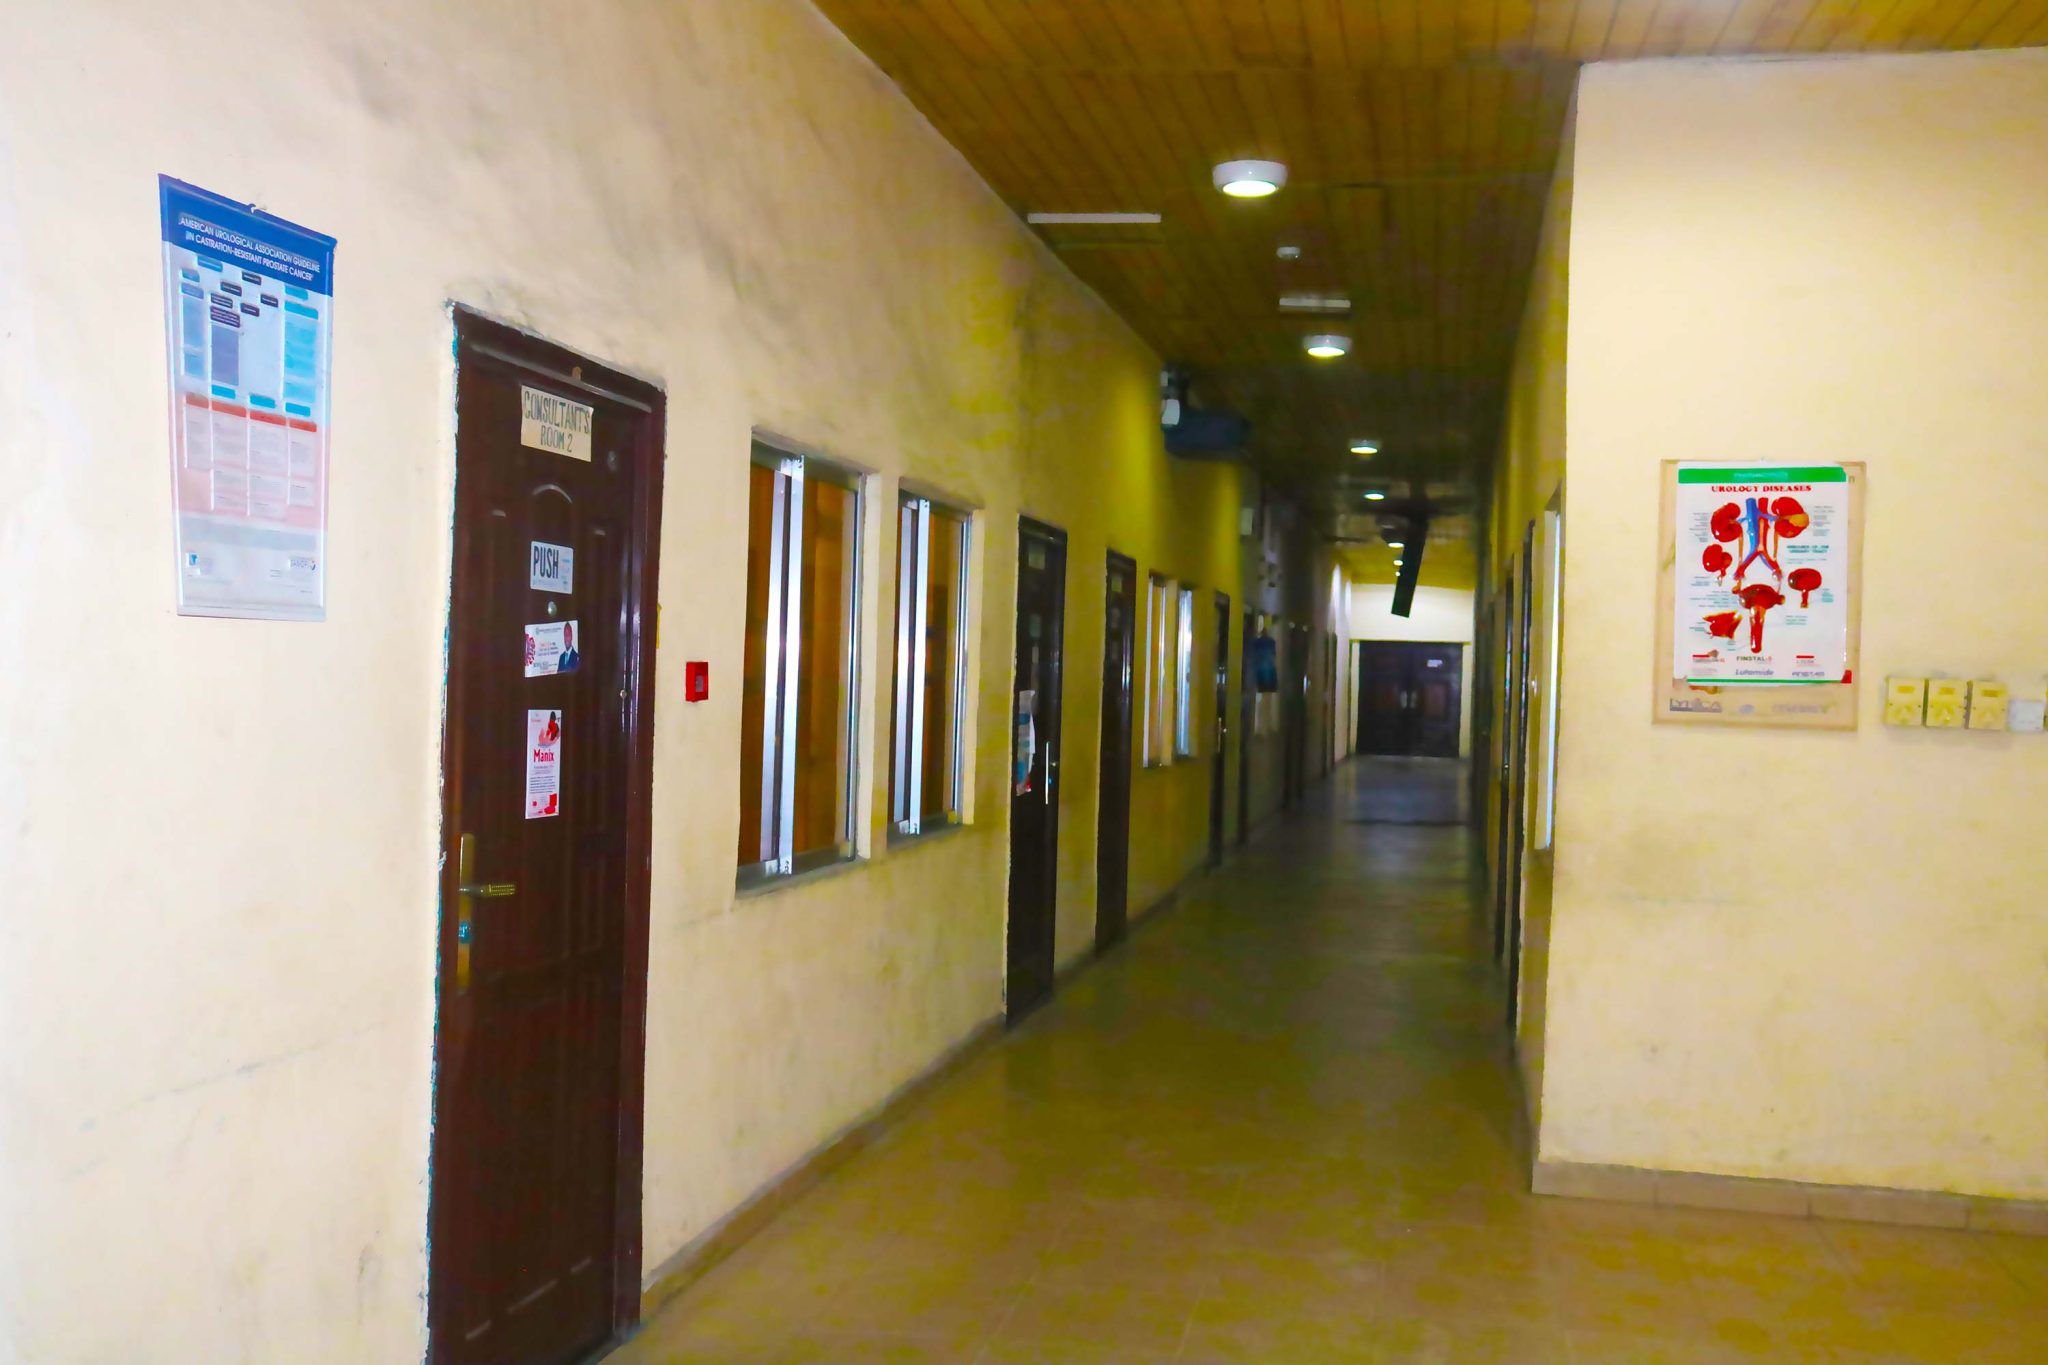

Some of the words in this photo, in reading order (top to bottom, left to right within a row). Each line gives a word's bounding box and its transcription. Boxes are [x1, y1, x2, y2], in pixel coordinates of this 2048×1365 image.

[178, 216, 215, 236] AMERICAN
[215, 228, 254, 250] UROLOGICAL
[254, 243, 293, 264] ASSOCIATION
[292, 256, 321, 273] GUIDELINE
[262, 257, 289, 274] PROSTATE
[288, 267, 314, 282] CANCER
[540, 424, 566, 451] ROOM
[567, 433, 574, 454] 2
[1711, 485, 1760, 493] UROLOGY
[1762, 484, 1812, 492] DISEASES
[532, 545, 560, 580] PUSH
[533, 748, 555, 763] Manix
